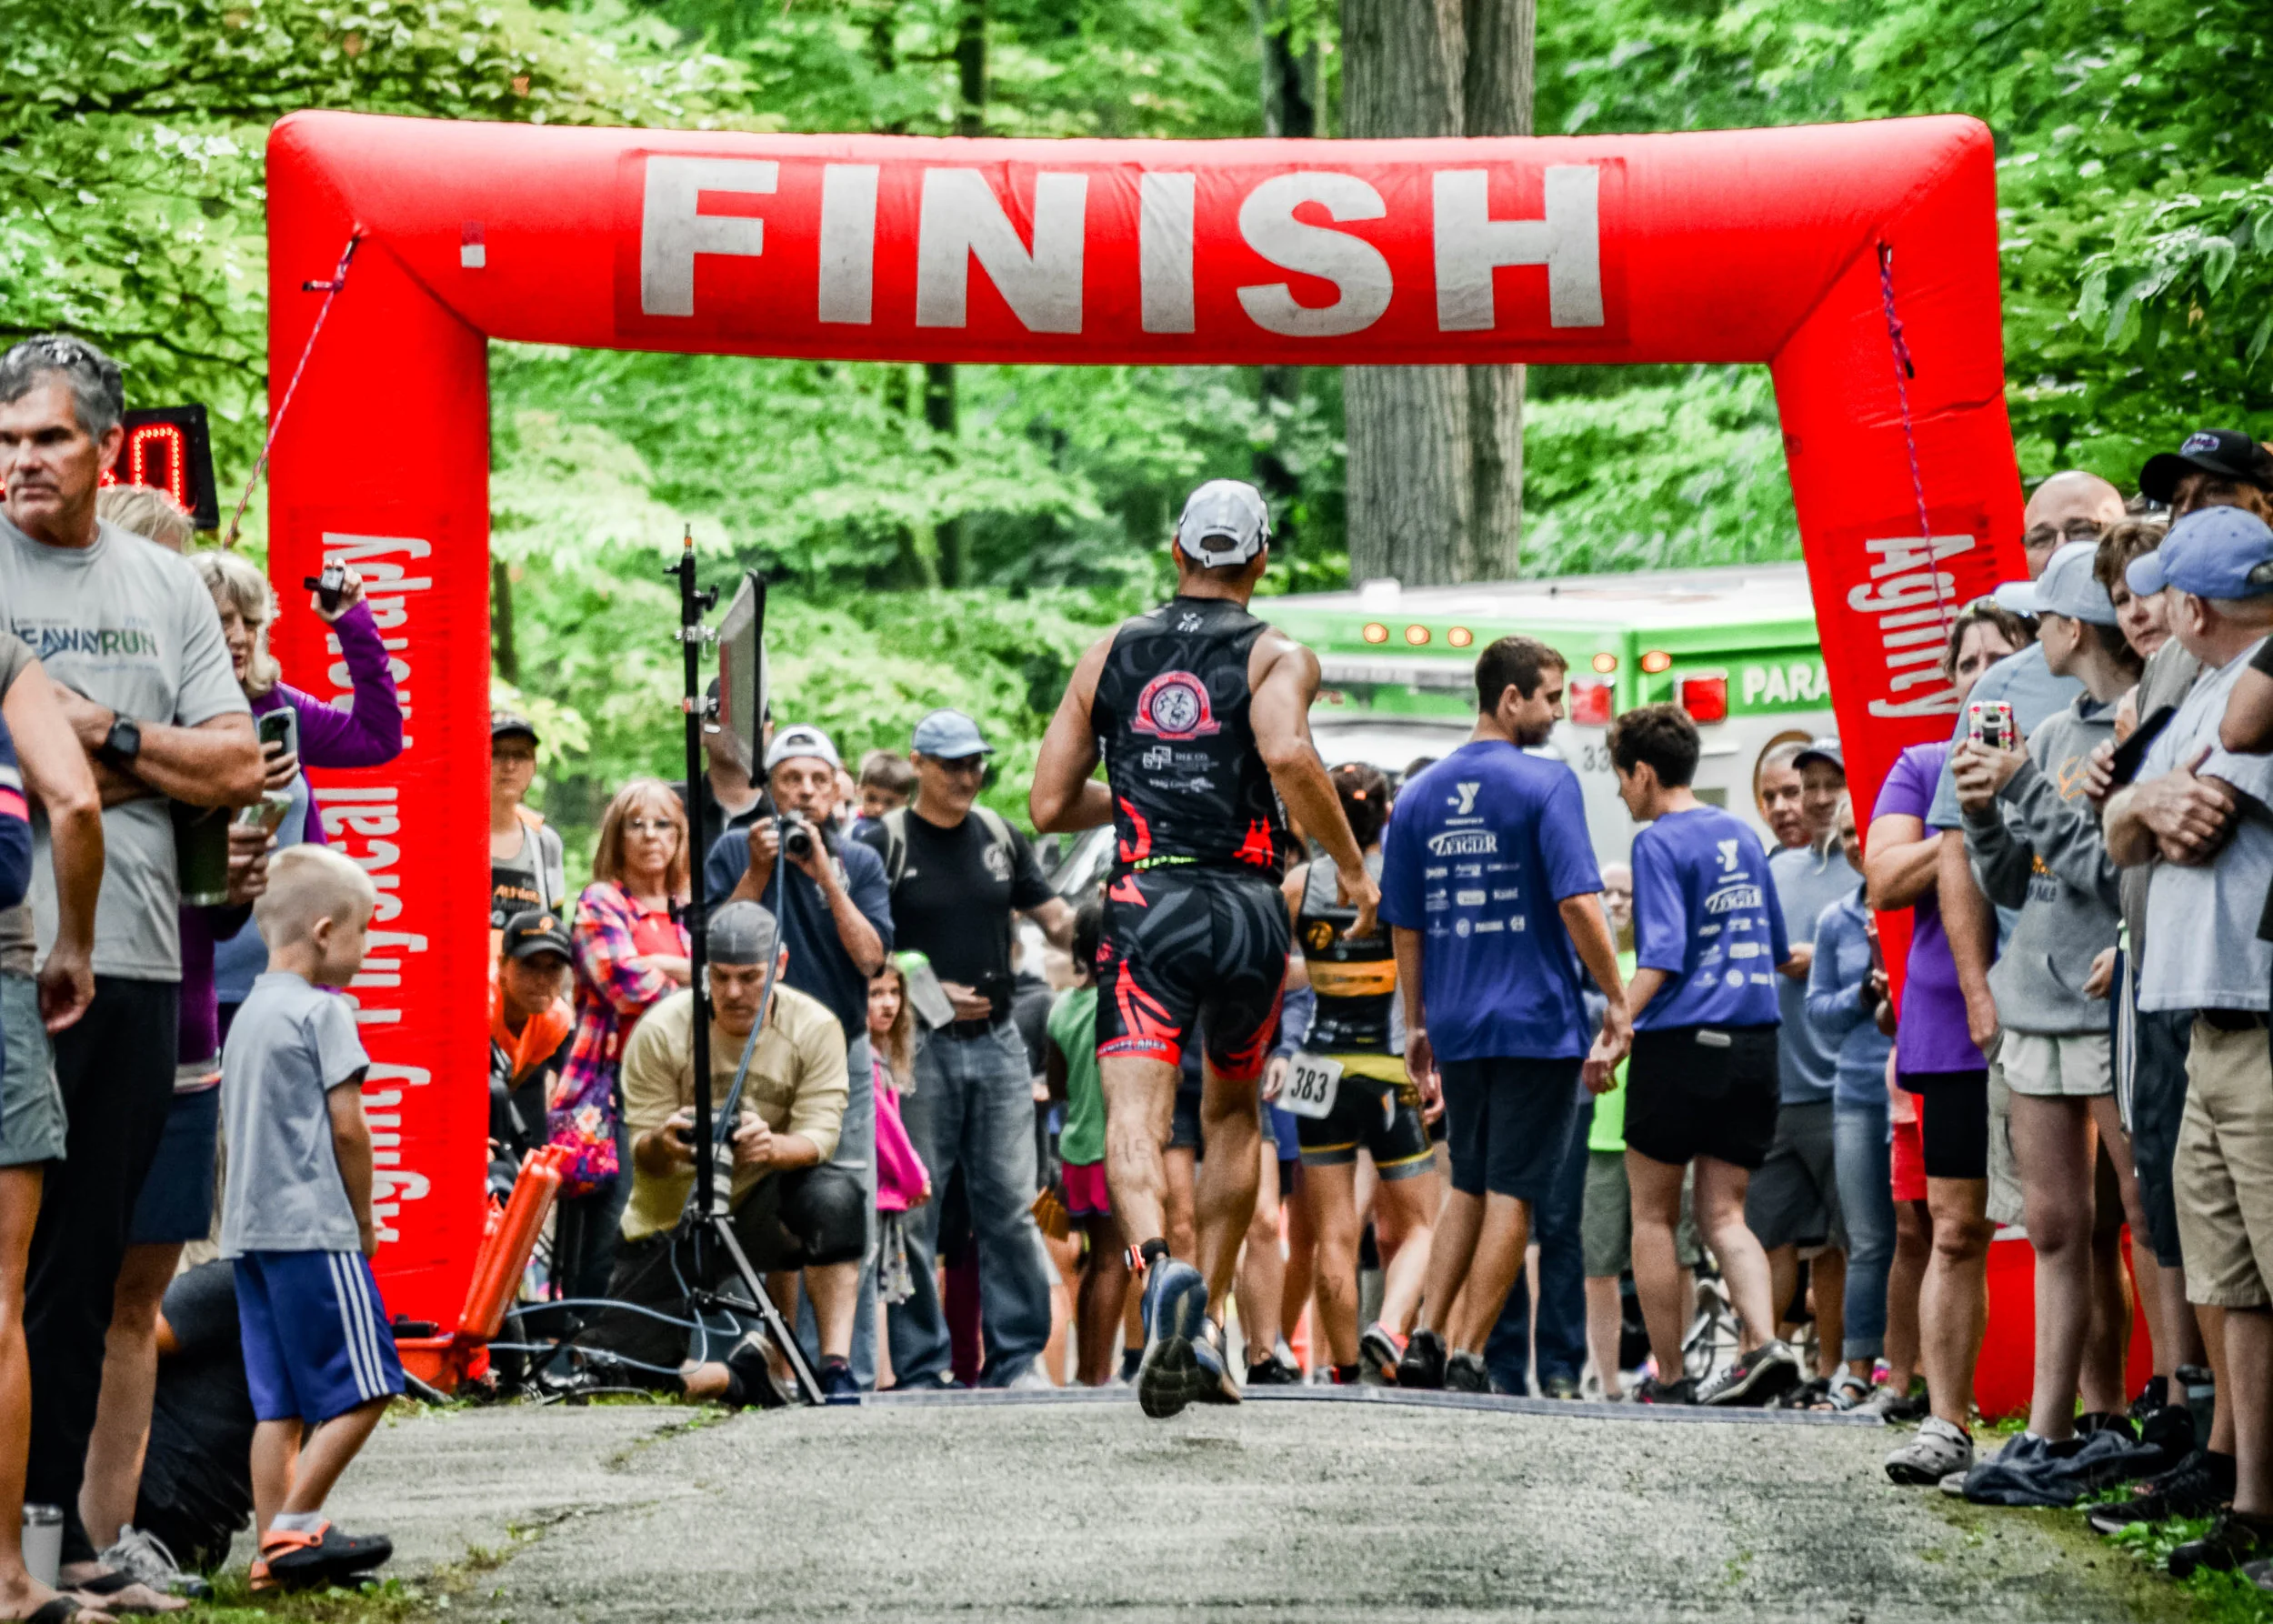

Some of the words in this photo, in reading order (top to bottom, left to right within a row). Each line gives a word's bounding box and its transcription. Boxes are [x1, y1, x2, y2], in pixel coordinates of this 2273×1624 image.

[640, 156, 1606, 337] FINISH
[1847, 534, 1976, 717] Agility
[1291, 1067, 1329, 1104] 383
